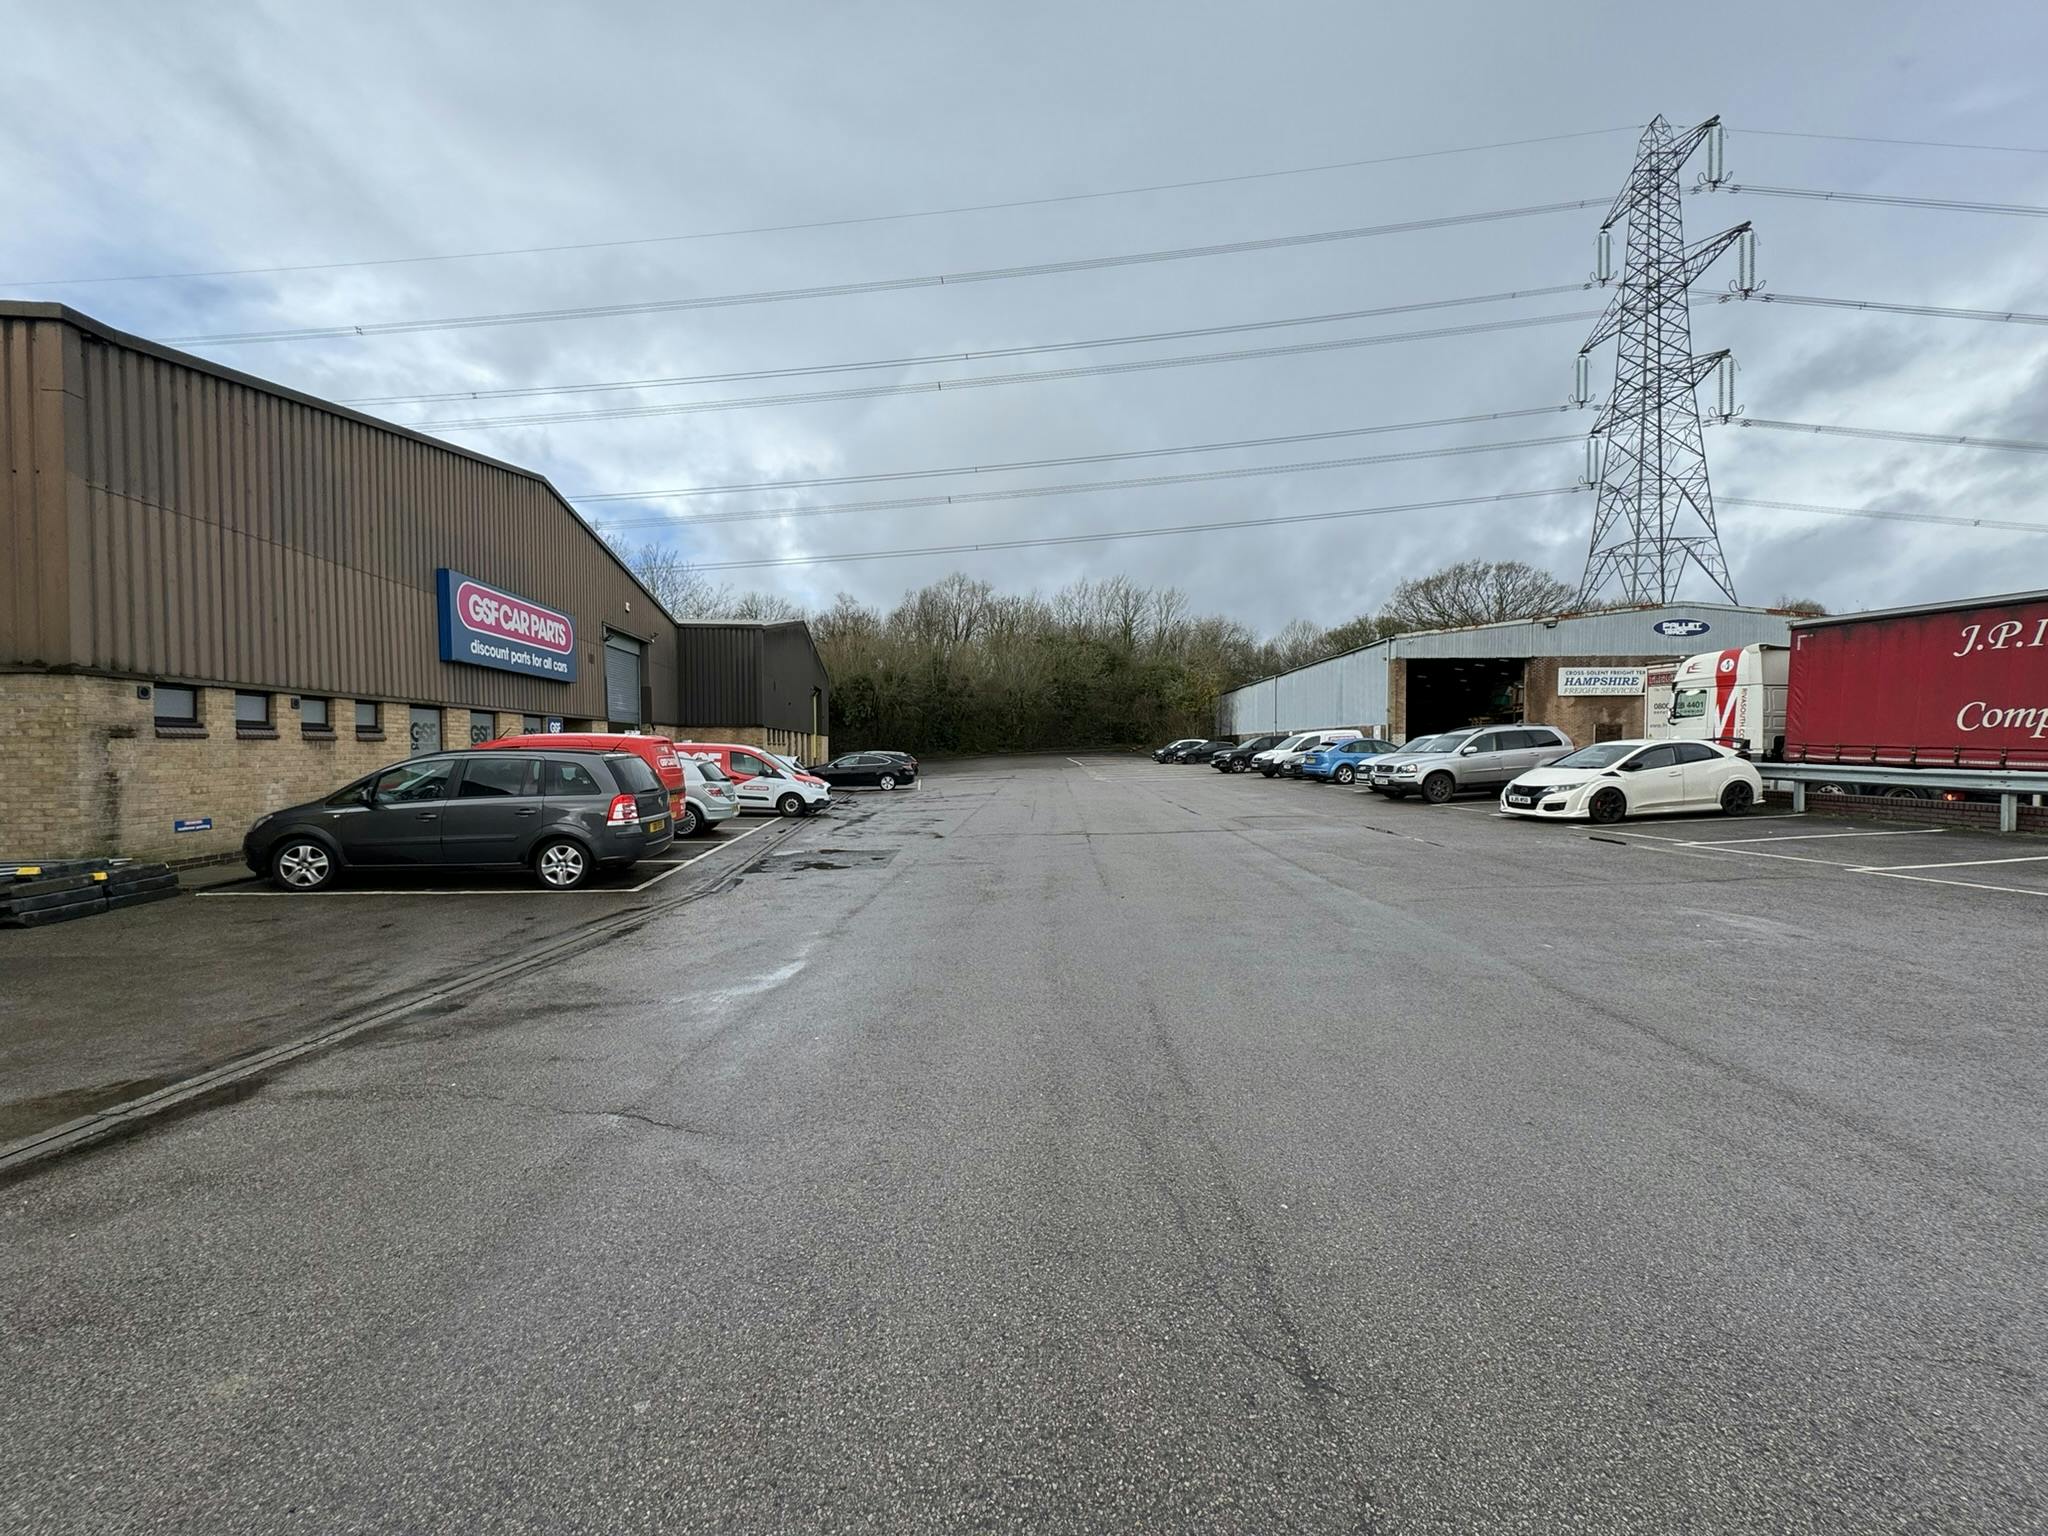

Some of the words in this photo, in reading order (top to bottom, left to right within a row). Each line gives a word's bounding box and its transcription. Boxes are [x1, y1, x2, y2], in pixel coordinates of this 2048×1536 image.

[468, 593, 499, 626] GSF
[500, 604, 530, 636] CAR
[530, 613, 566, 646] PARTS
[470, 640, 510, 661] discount
[511, 650, 531, 665] parts
[531, 653, 542, 668] for
[542, 656, 552, 670] all
[552, 660, 568, 673] cars
[1563, 686, 1599, 695] FREIGHT
[1600, 686, 1641, 695] SERVICES
[1564, 676, 1640, 687] HAMPSHIRE
[1686, 701, 1704, 709] 4401
[1956, 701, 2048, 739] Comp
